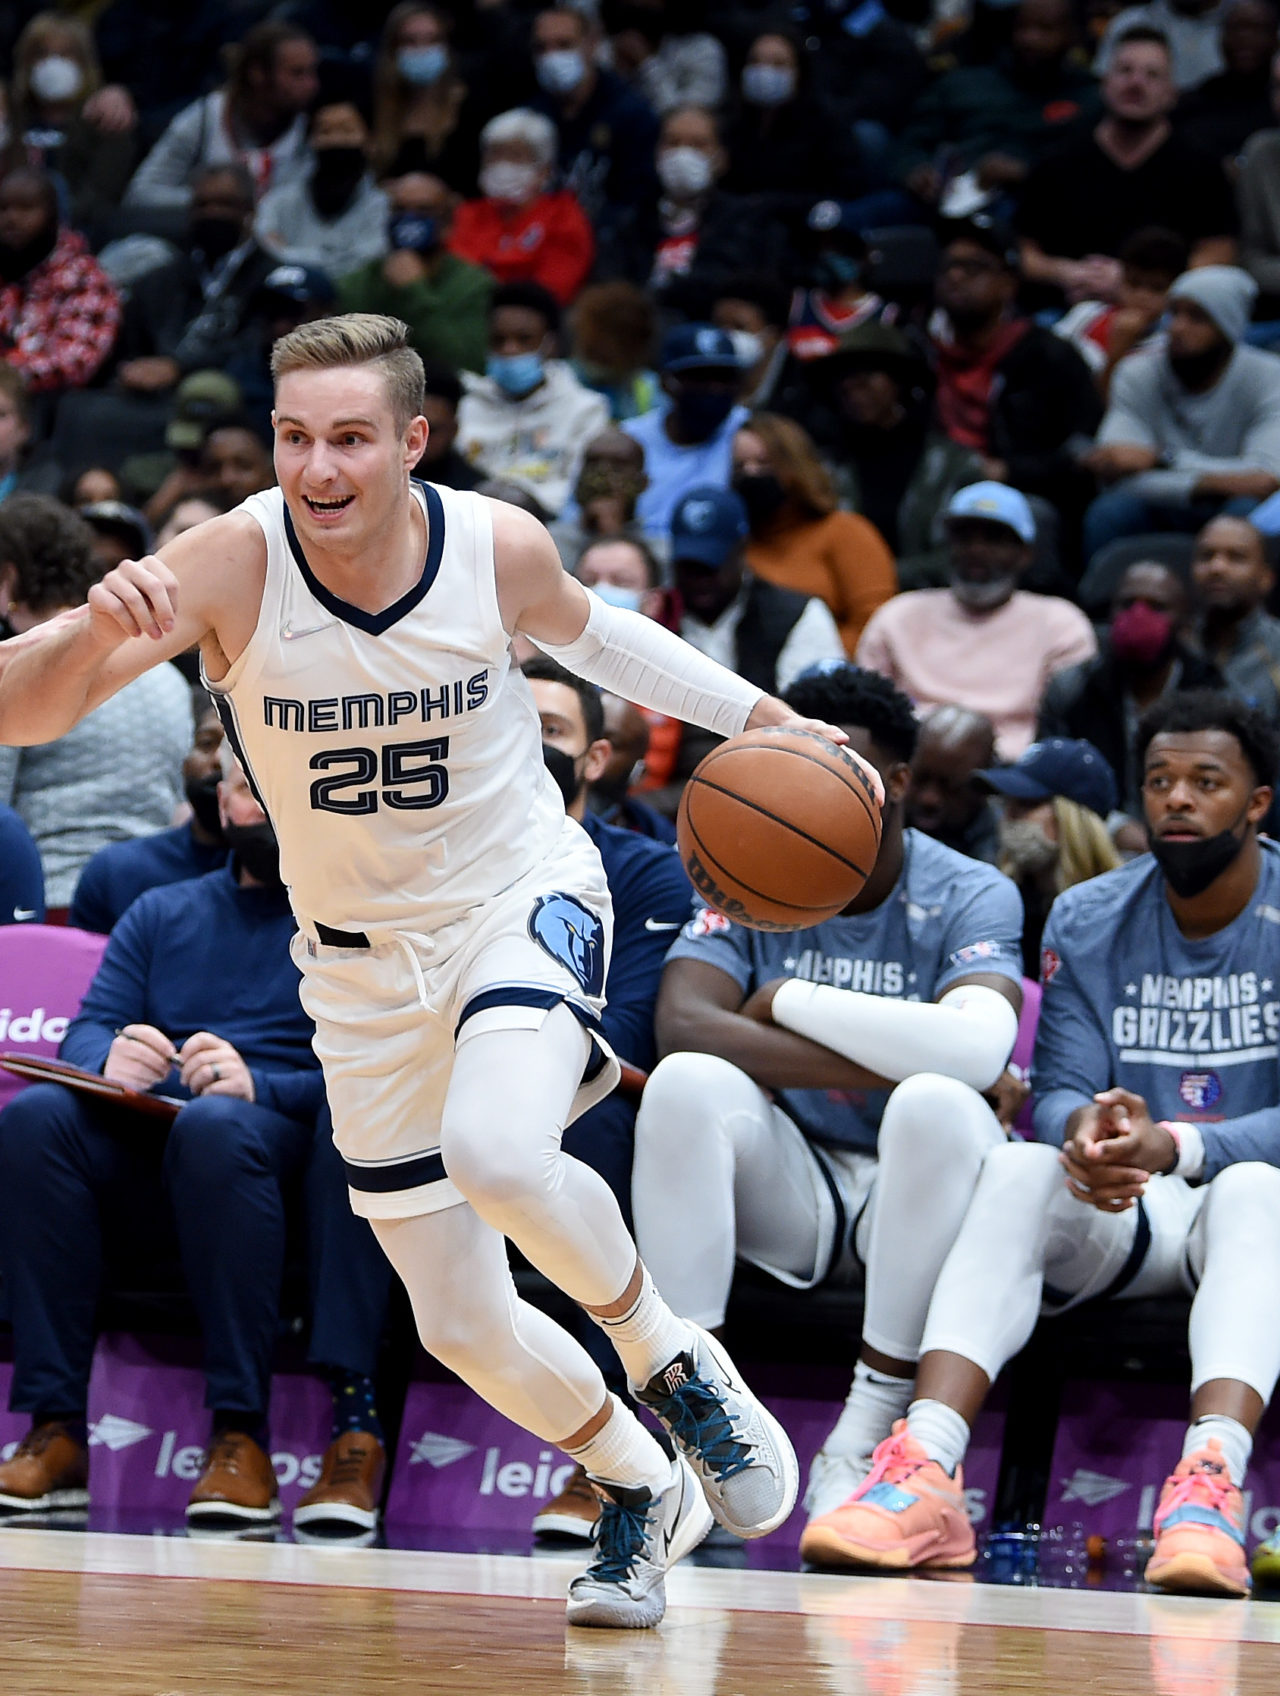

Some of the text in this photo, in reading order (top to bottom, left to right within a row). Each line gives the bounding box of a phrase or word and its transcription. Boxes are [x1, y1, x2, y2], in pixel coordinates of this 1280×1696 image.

[263, 669, 489, 733] MEMPHIS
[309, 736, 450, 815] 25
[1140, 972, 1258, 1010] MEMPHIS
[1112, 1000, 1280, 1051] GRIZZLIES
[154, 1430, 323, 1489] leos
